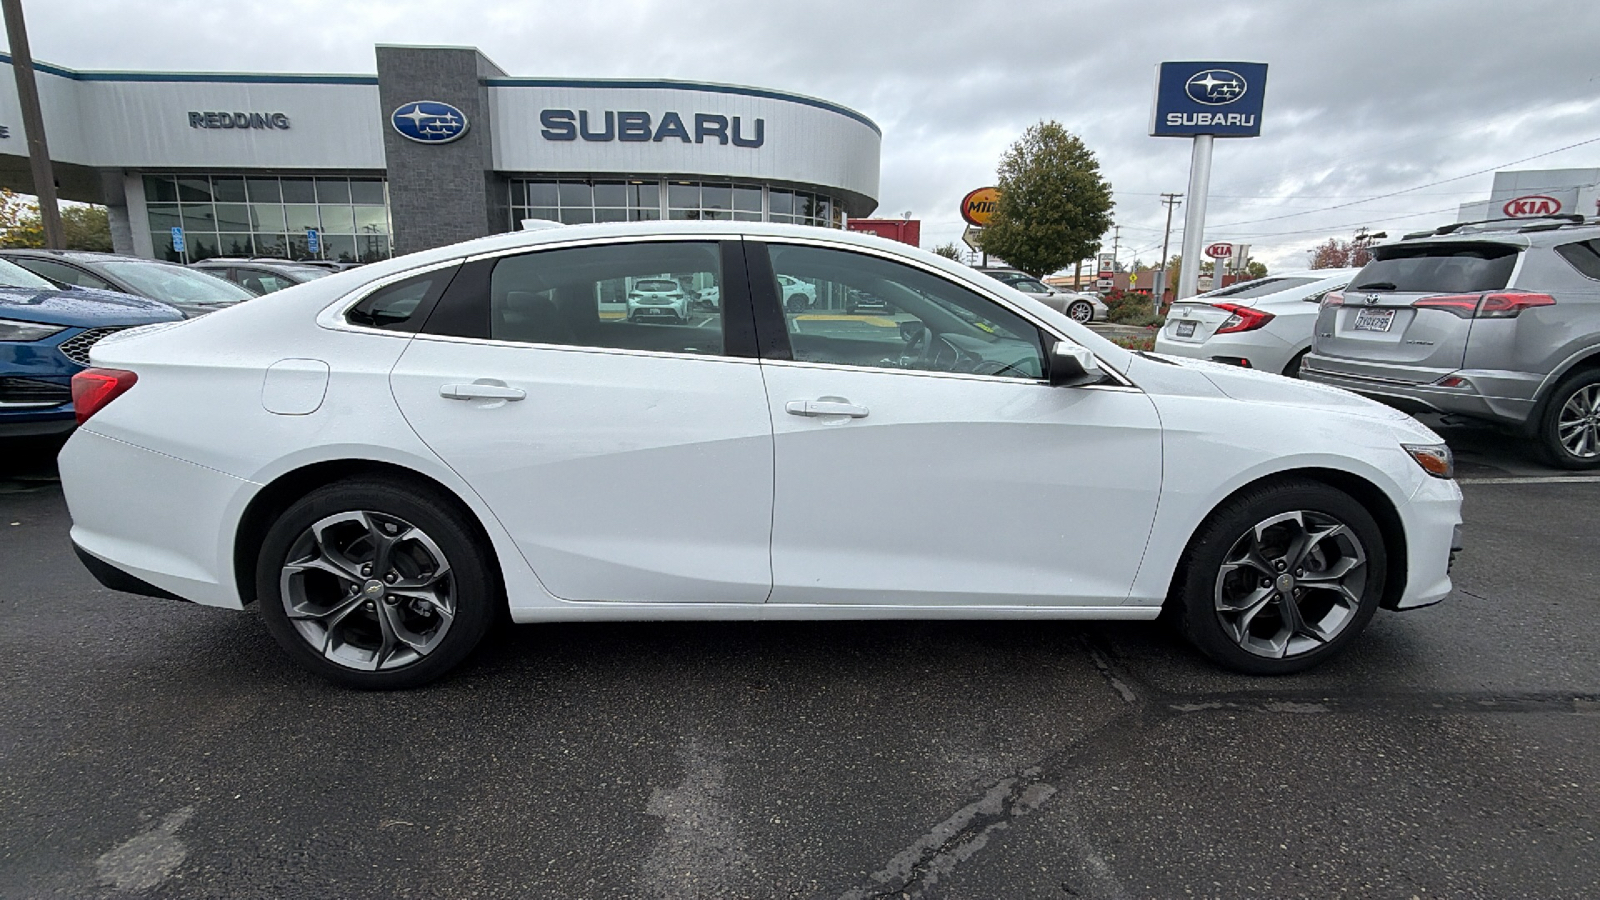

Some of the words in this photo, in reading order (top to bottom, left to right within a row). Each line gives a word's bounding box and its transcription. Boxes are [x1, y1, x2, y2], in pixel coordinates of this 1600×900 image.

[188, 112, 290, 130] REDDING
[1166, 113, 1255, 127] SUBARU
[540, 109, 765, 149] SUBARU
[1513, 201, 1551, 215] KIA
[1212, 246, 1232, 256] KIA
